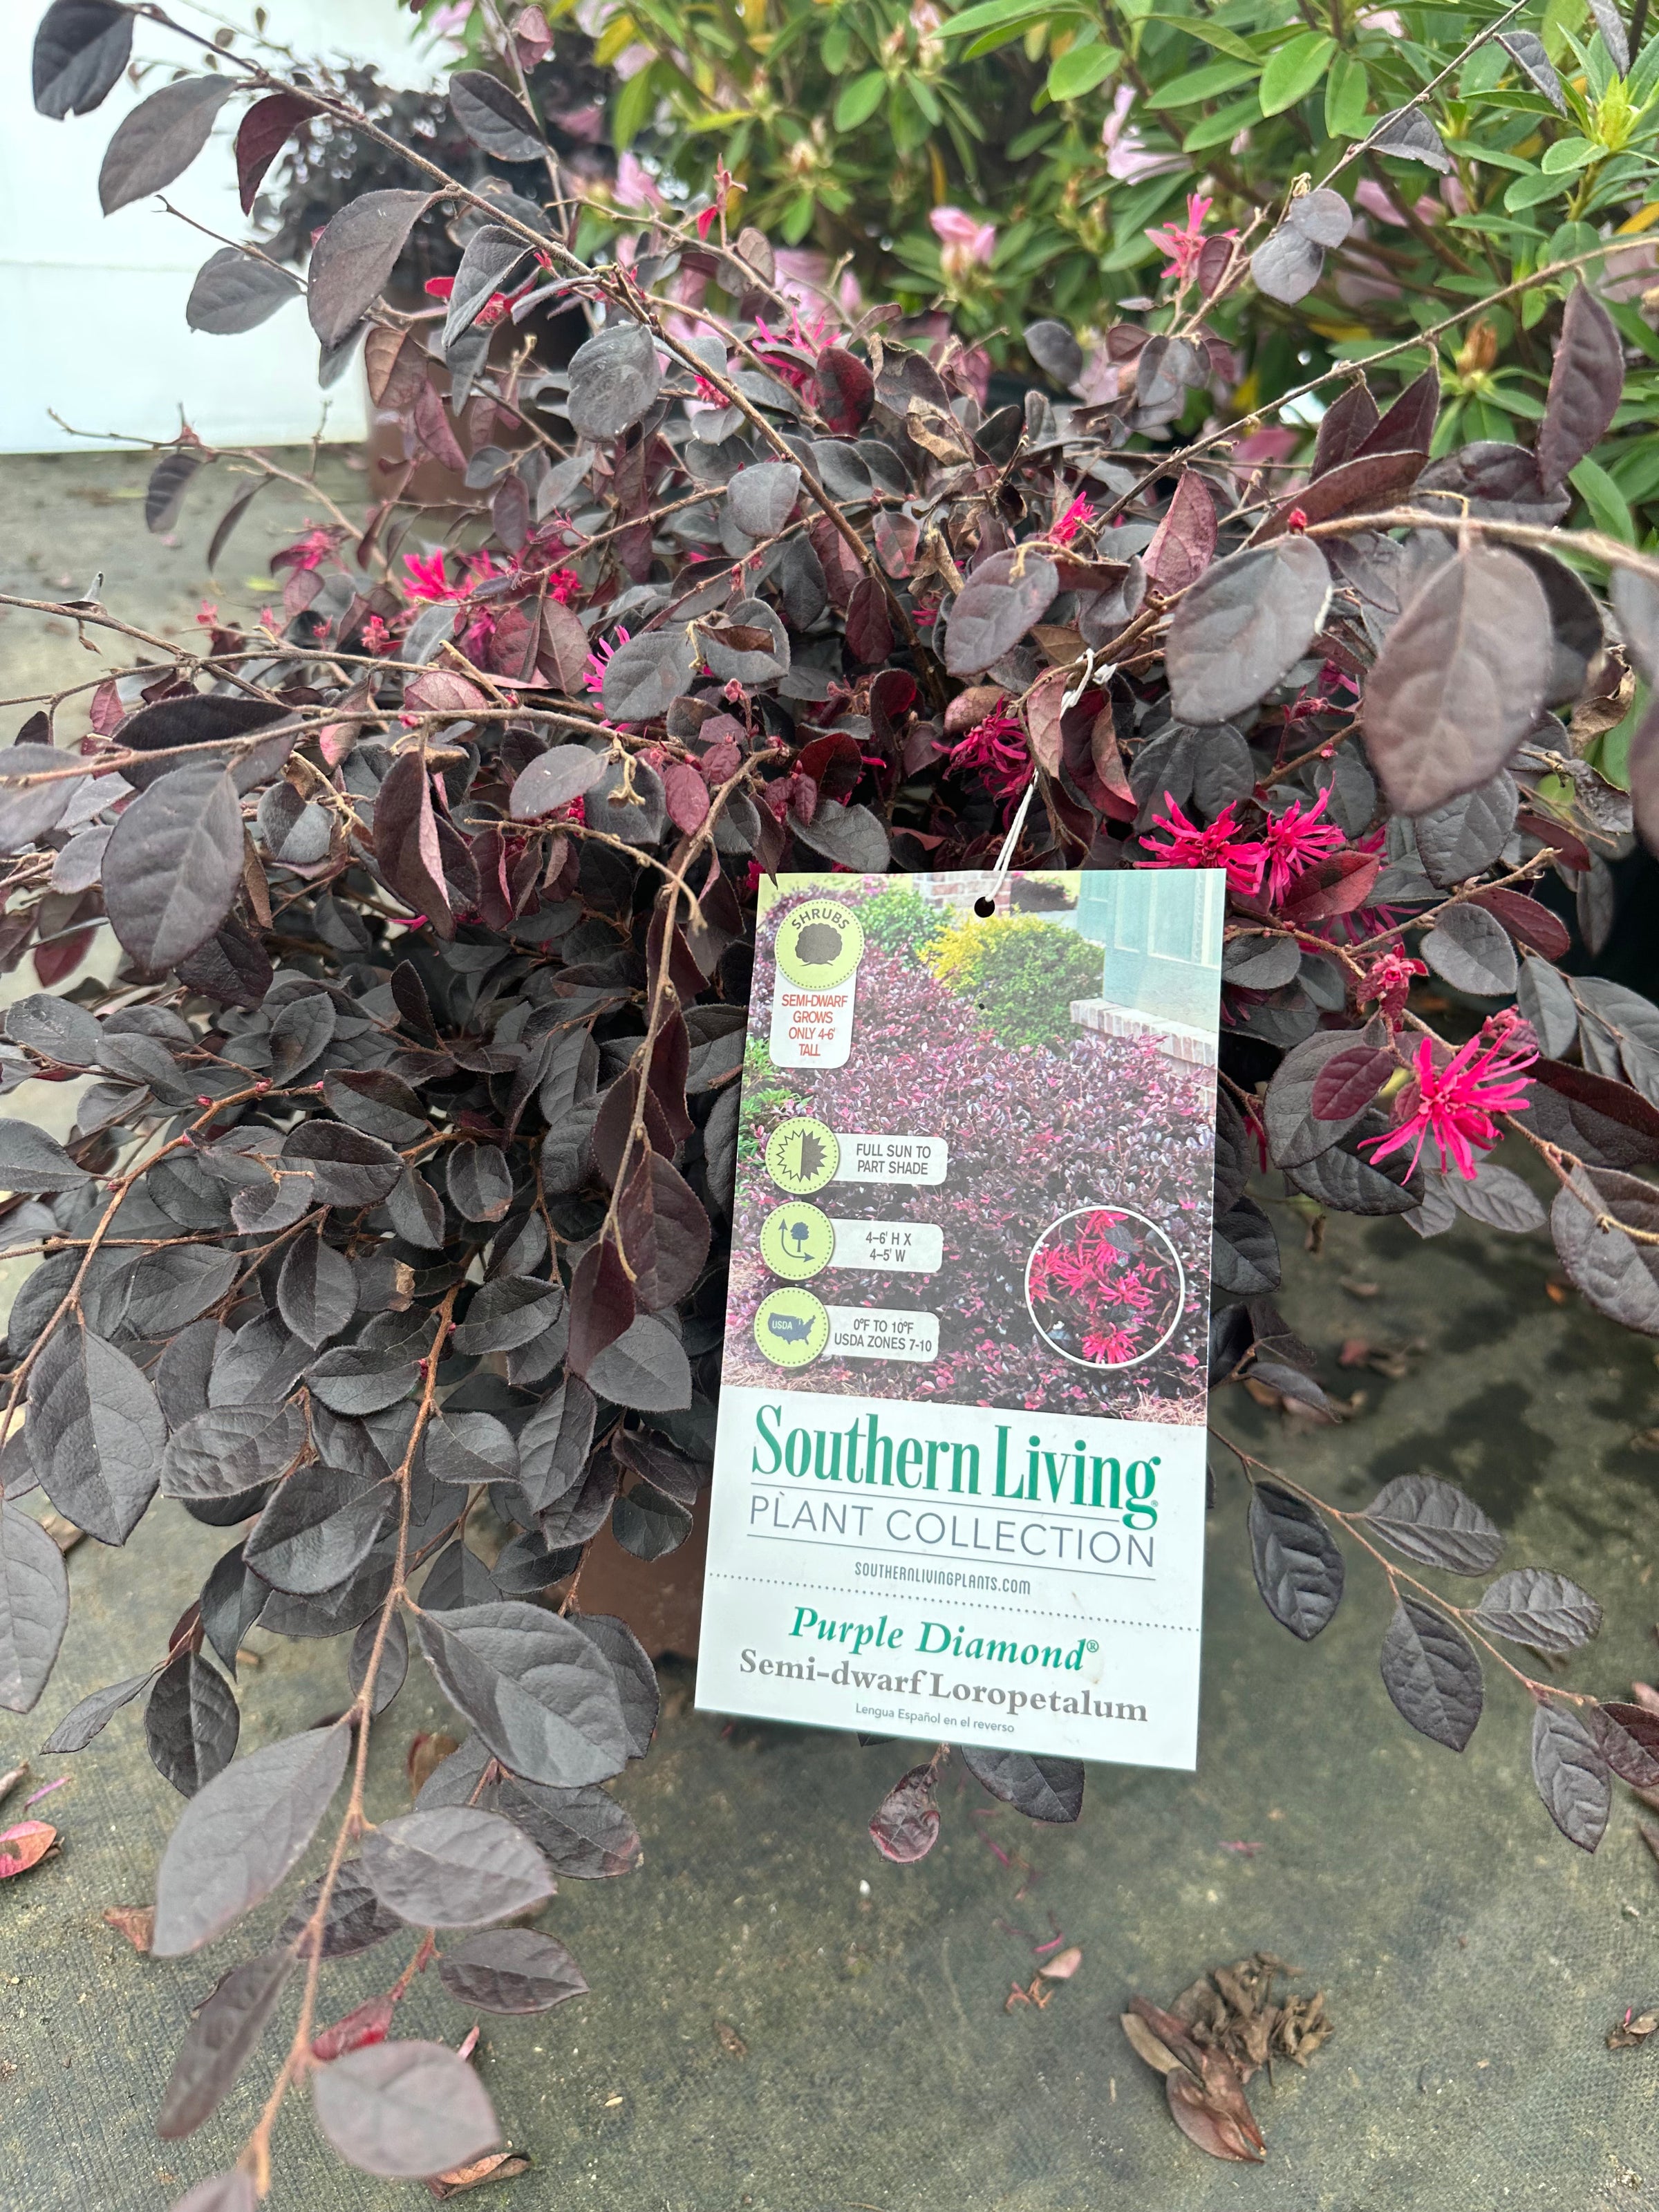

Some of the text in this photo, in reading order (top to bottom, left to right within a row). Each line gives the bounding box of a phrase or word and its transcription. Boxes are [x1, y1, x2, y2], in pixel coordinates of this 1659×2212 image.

[791, 908, 850, 930] SHRUBS
[782, 994, 848, 1009] SEMI-DWARF
[793, 1011, 833, 1024] GROWS
[789, 1027, 815, 1040] ONLY
[798, 1043, 821, 1056] TALL
[856, 1143, 931, 1159] FULL SUN TO
[857, 1160, 928, 1175] PART SHADE
[892, 1232, 899, 1246] H
[904, 1232, 912, 1246] X
[896, 1249, 906, 1262] W
[771, 1320, 793, 1330] USDA
[874, 1320, 888, 1333] TO
[834, 1333, 932, 1352] USDA ZONES 7-10
[752, 1405, 982, 1495] Southern
[749, 1495, 1154, 1568] PLANT COLLECTION
[854, 1561, 1031, 1595] SOUTHERNLIVINGPLANTS.COM
[788, 1606, 903, 1655] Purple
[740, 1648, 1148, 1723] Semi-dwarf Loropetalum
[856, 1703, 1015, 1733] Lengua Español en el reverso
